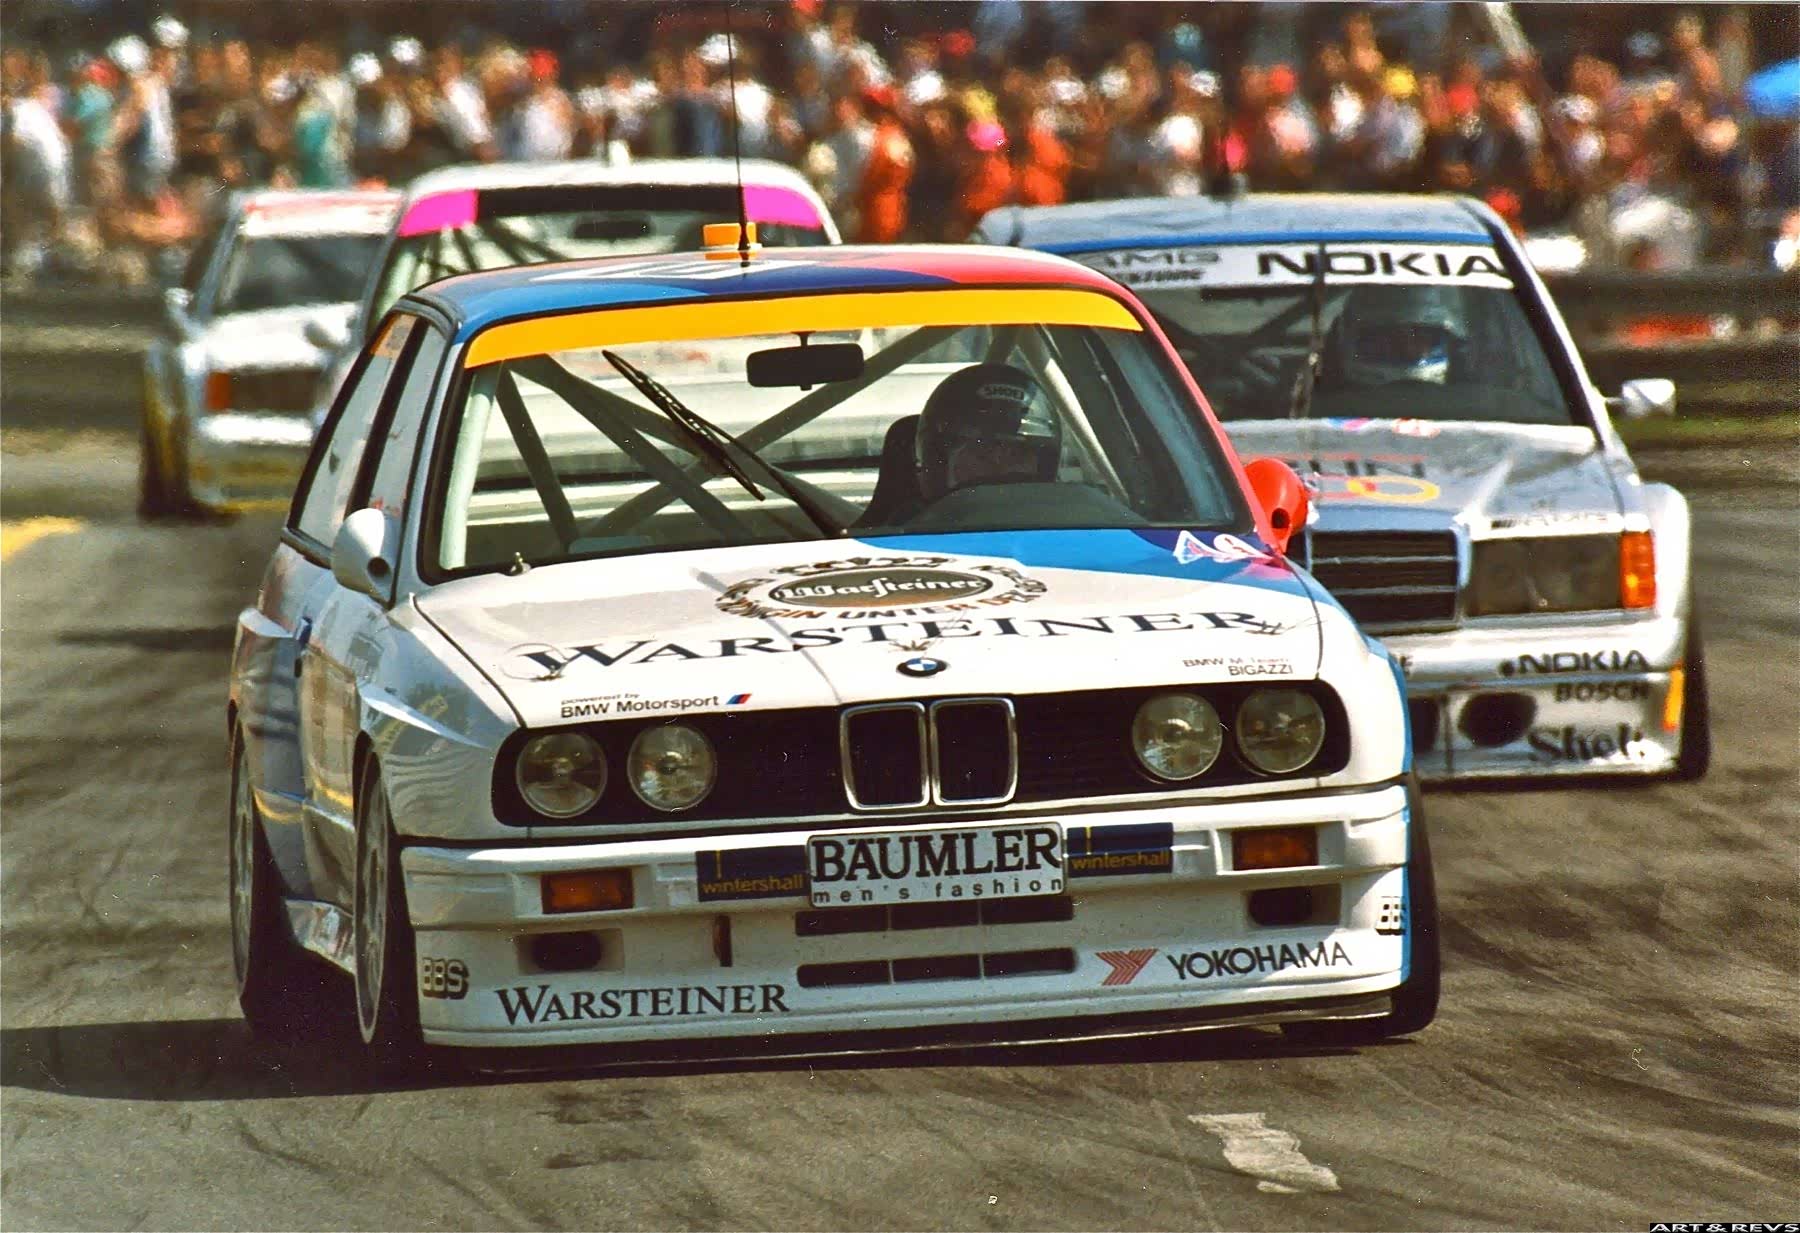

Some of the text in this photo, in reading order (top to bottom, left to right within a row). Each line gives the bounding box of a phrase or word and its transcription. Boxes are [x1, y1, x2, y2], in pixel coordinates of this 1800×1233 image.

[1258, 250, 1506, 276] NOKIA
[772, 576, 988, 599] Warsteiner
[517, 611, 1262, 672] WARSTEINER
[1182, 657, 1224, 668] BMW
[1228, 664, 1294, 676] BIGAZZI
[1519, 650, 1650, 674] NOKIA
[1554, 682, 1650, 702] BOSCH
[561, 696, 719, 718] BMW Motorsport
[811, 827, 1063, 883] BÄUMLER
[1072, 850, 1171, 870] wintershall
[701, 874, 805, 895] wintershall
[812, 877, 1063, 904] men's fashion
[1167, 942, 1353, 980] YOKOHAMA
[422, 957, 470, 1000] BBS
[495, 984, 791, 1025] WARSTEINER
